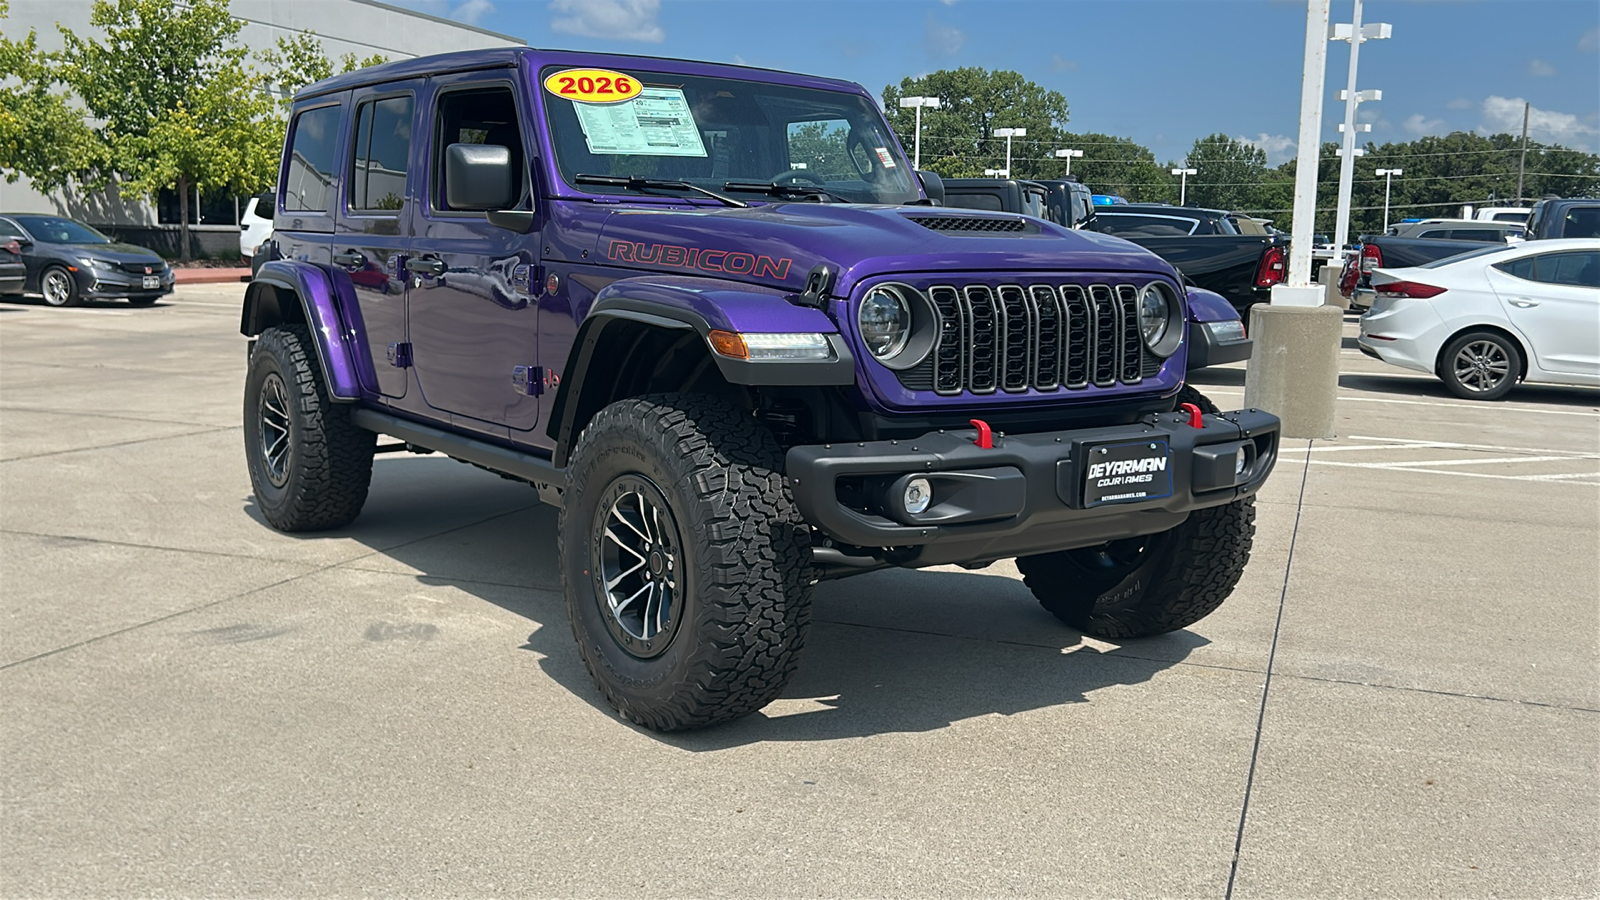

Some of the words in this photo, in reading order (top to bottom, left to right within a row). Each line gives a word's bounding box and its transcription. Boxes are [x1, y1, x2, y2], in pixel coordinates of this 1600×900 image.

[558, 77, 632, 94] 2026
[607, 240, 793, 280] RUBICON
[1088, 456, 1167, 479] DEYARMAN
[1125, 474, 1153, 484] AMES
